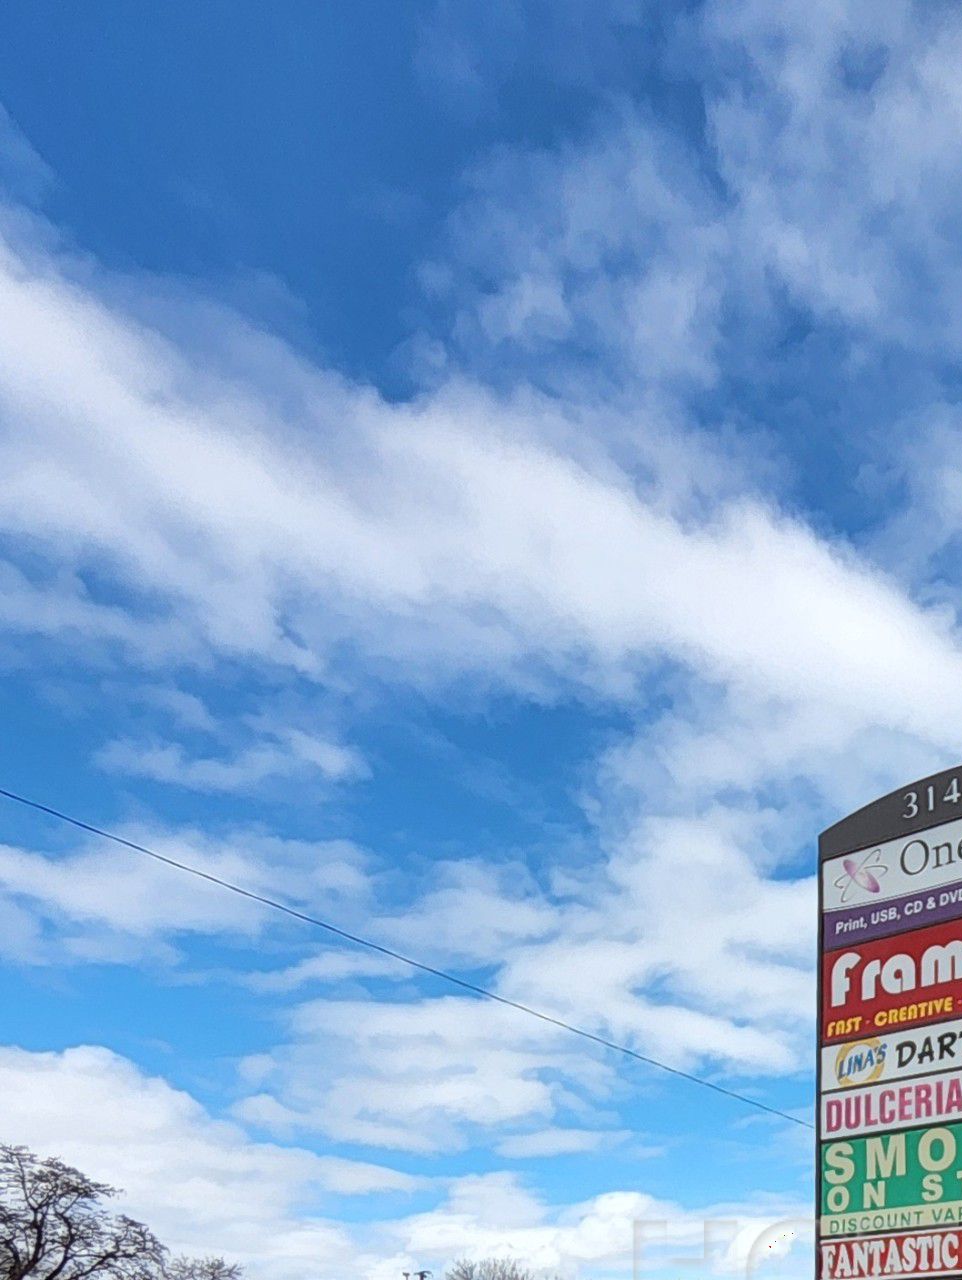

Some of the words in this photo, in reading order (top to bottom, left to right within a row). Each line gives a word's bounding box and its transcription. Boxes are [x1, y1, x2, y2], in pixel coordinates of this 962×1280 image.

[835, 918, 868, 935] Print,
[871, 907, 901, 925] USB,
[904, 899, 923, 916] CD
[926, 896, 936, 910] &
[826, 1016, 862, 1037] FAST
[874, 996, 953, 1027] CREATIVE
[837, 1043, 888, 1080] LINA'S
[826, 1180, 886, 1213] ON
[829, 1211, 923, 1234] DISCOUNT
